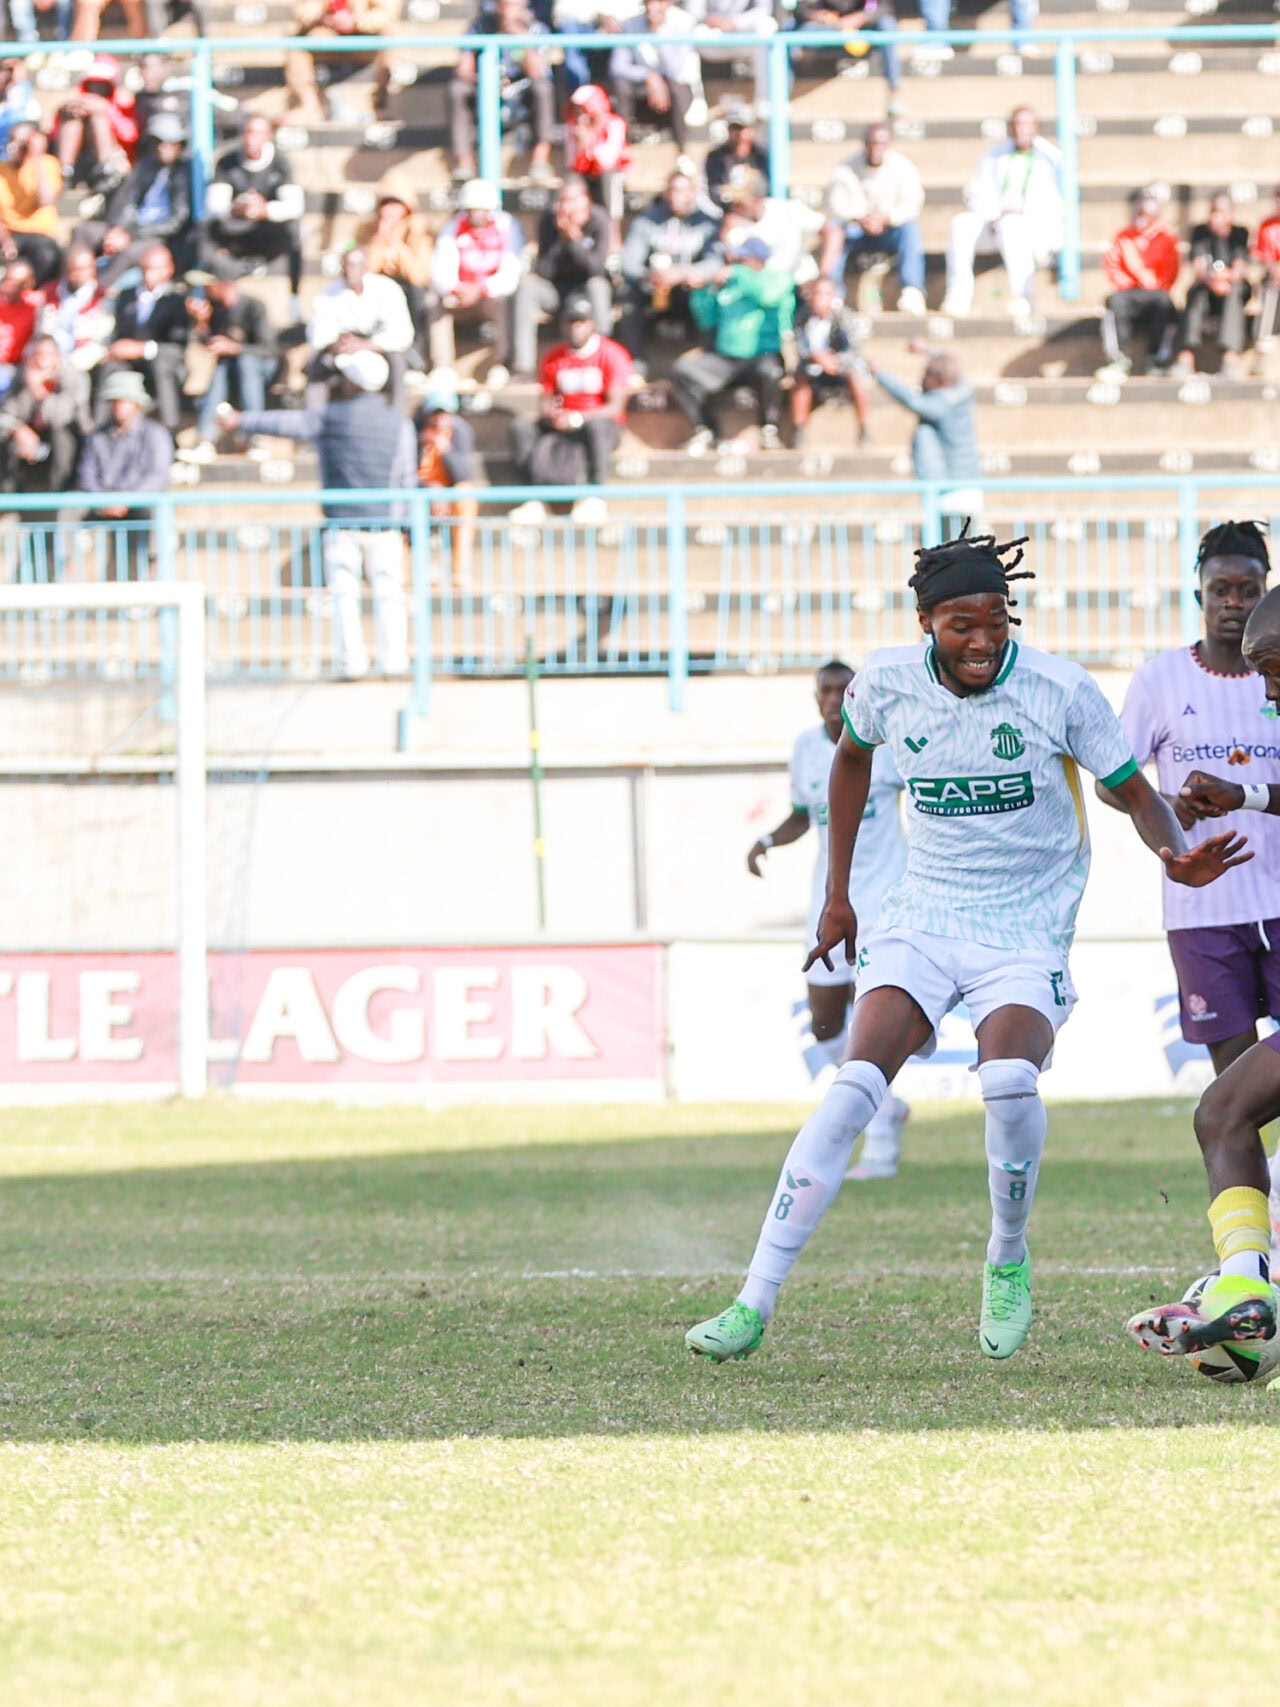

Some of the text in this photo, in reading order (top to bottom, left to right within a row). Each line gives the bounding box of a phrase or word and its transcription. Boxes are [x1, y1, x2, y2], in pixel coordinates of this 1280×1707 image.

[912, 776, 1026, 803] CAPS
[0, 970, 145, 1061] LE
[1009, 1181, 1027, 1201] 8
[775, 1193, 794, 1221] 8
